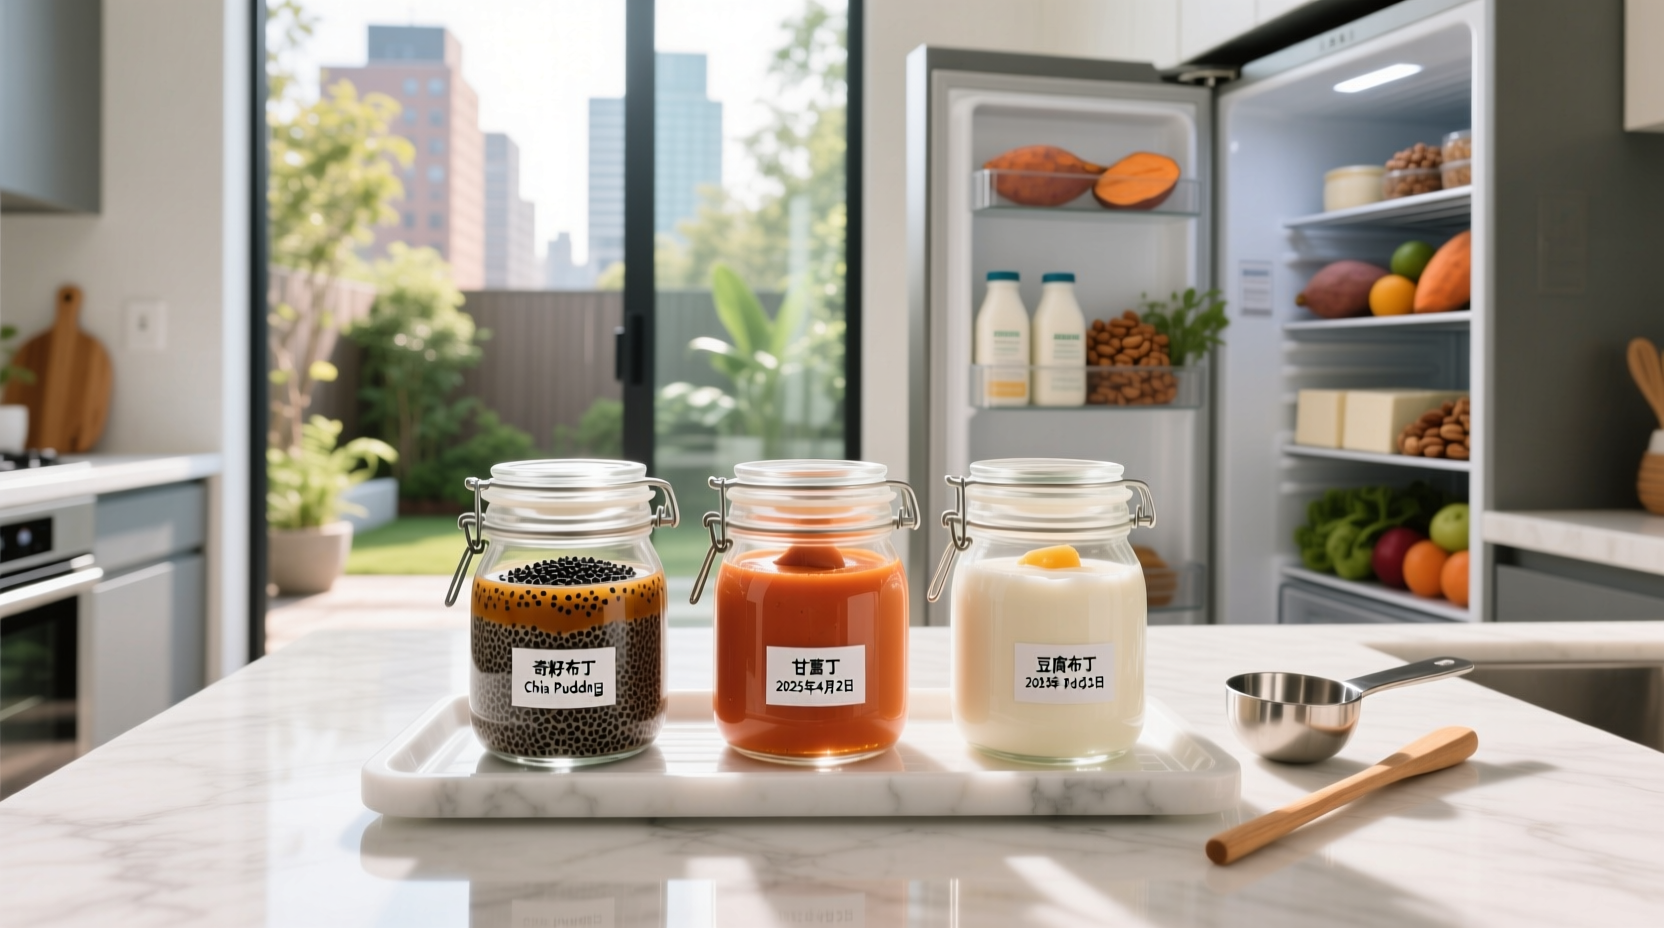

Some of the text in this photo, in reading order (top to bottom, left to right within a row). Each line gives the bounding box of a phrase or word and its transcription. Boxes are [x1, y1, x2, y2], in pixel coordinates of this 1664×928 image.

[524, 680, 550, 694] Chia
[776, 679, 854, 695] 2025年4月2日
